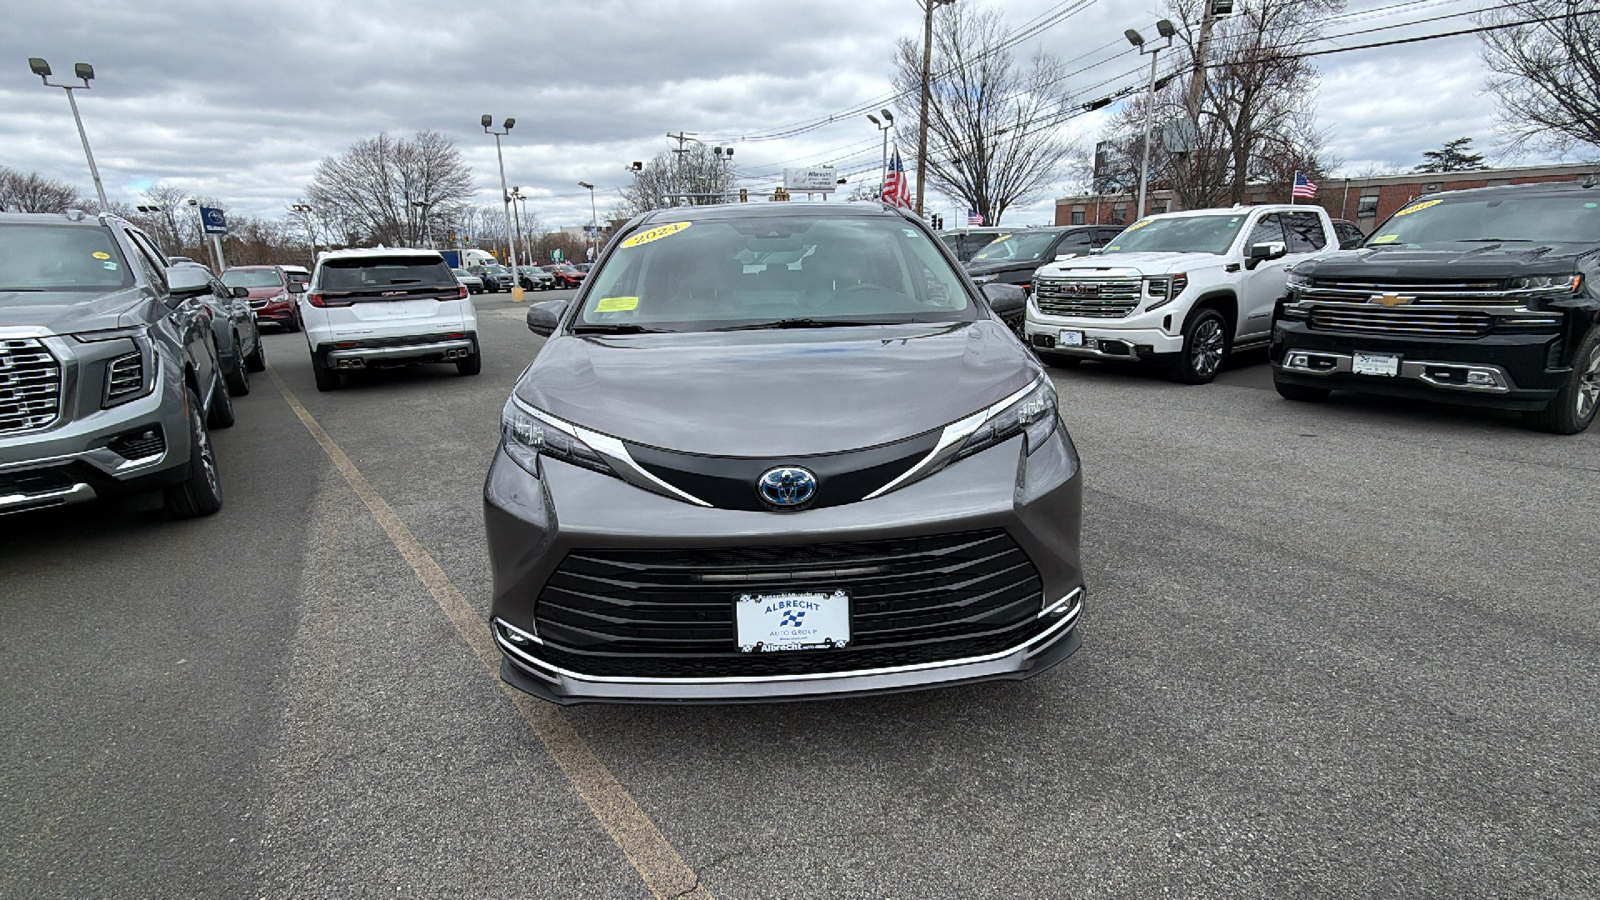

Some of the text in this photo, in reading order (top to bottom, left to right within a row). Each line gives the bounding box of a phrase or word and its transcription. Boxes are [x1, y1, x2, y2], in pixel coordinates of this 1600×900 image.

[634, 225, 681, 244] 2024
[765, 600, 820, 614] ALBRECHT
[761, 642, 802, 652] Albrecht
